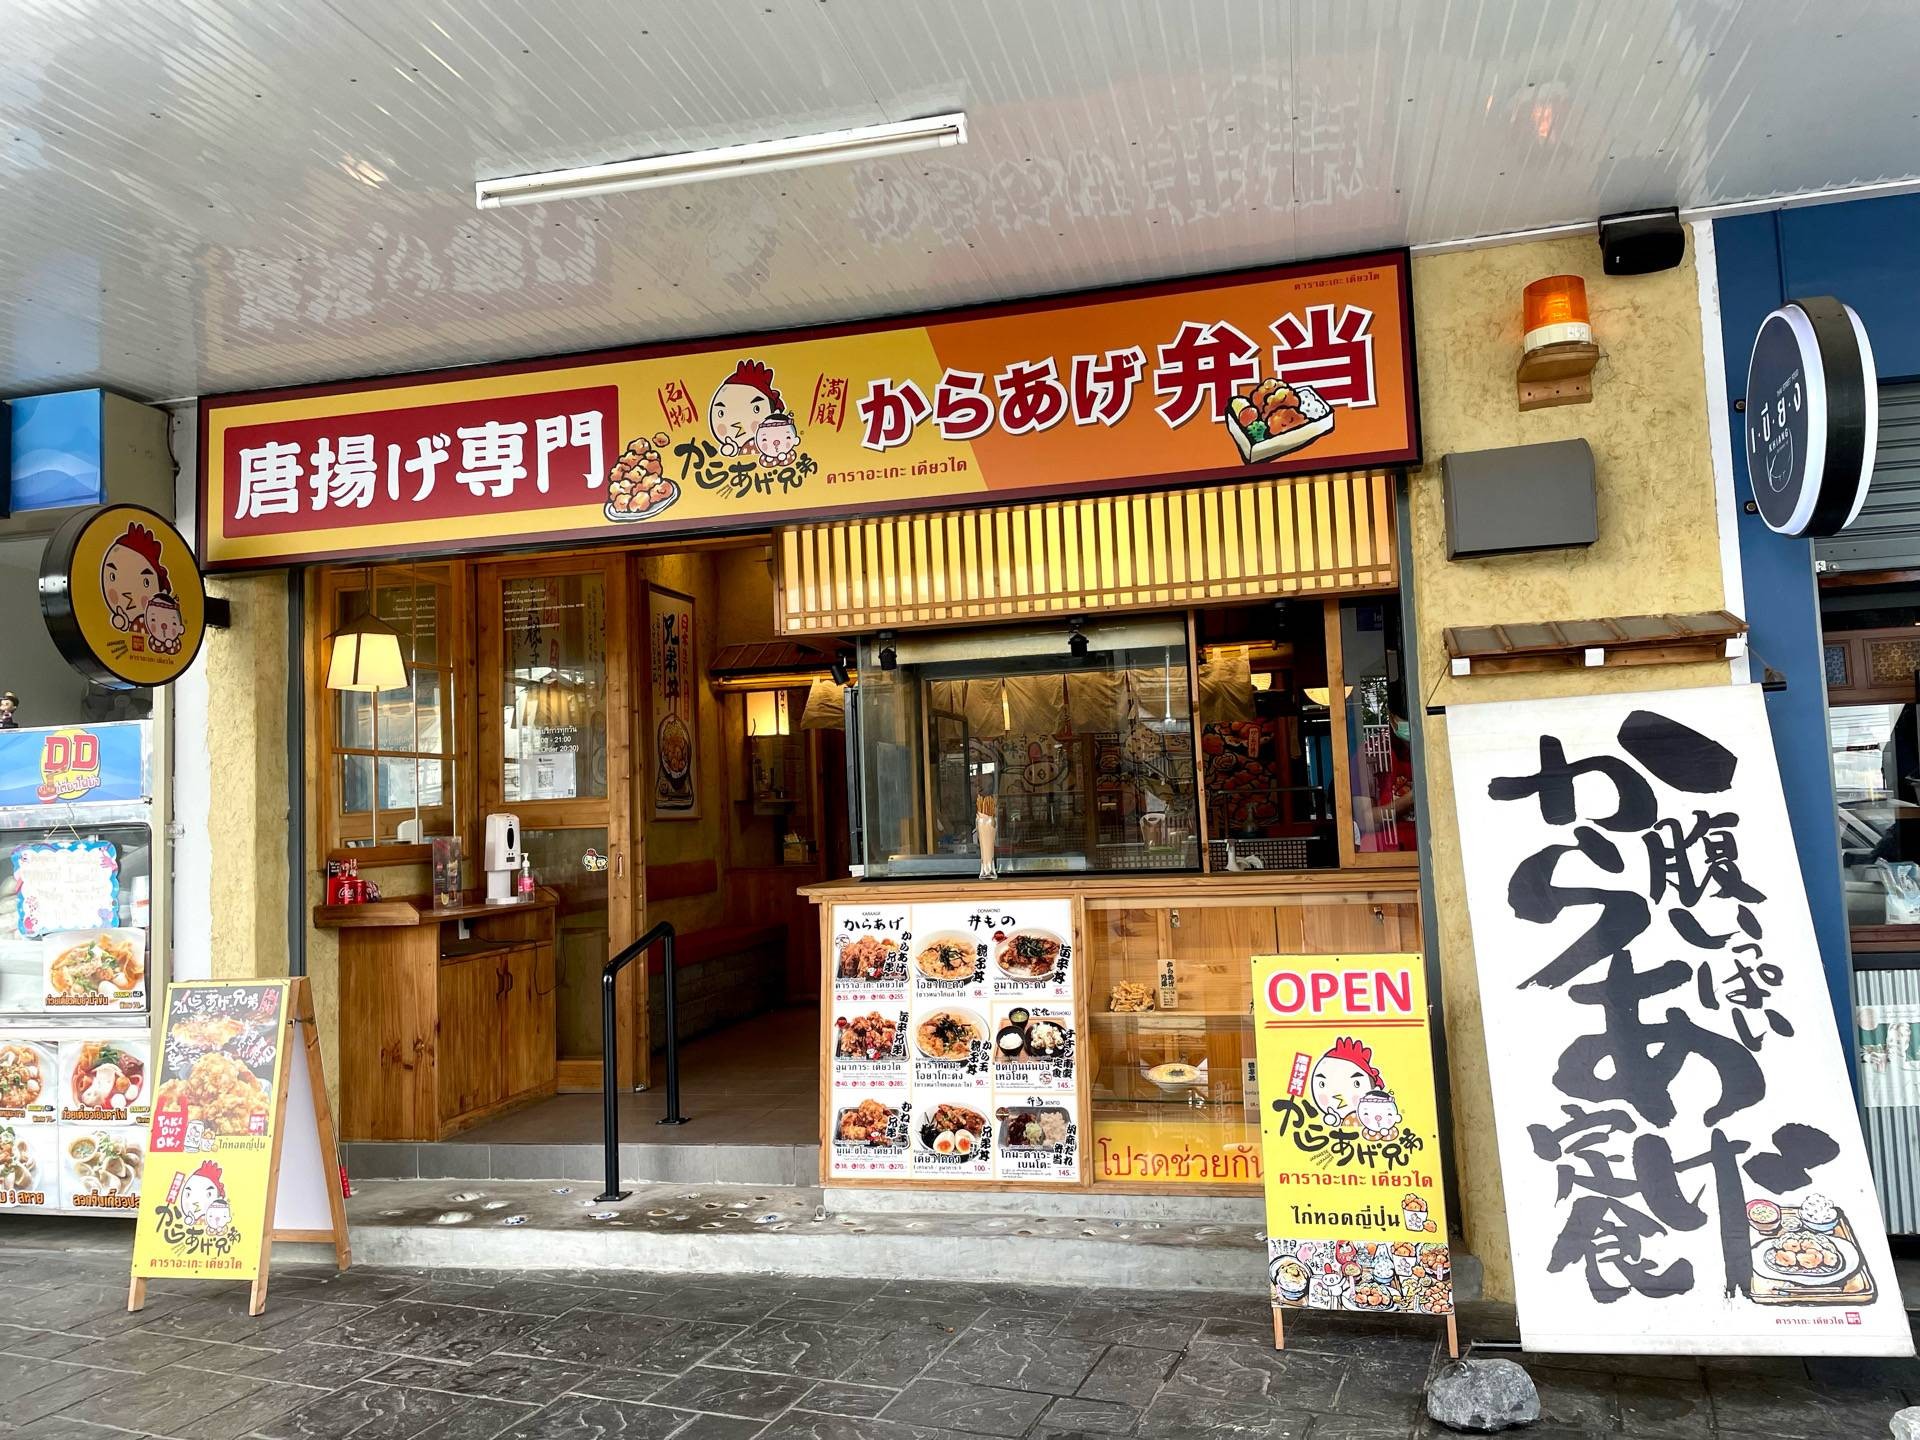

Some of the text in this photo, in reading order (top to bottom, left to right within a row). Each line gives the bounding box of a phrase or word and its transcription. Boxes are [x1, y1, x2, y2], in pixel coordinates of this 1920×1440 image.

[665, 382, 693, 428] 名物
[815, 378, 845, 426] 満腹
[233, 410, 605, 520] 唐揚げ専門
[826, 457, 968, 485] คาราอะเกะ เคียวได
[44, 733, 99, 771] DD
[844, 917, 904, 931] からあげ
[968, 915, 1016, 931] 丼もの
[1642, 809, 1795, 1053] 腹いっぱい
[1268, 971, 1412, 1014] OPEN
[1280, 1170, 1434, 1188] คาราอะเกะ เคียวได
[1291, 1204, 1400, 1232] ไก่ทอดญี่ปุ่น
[1527, 1103, 1694, 1304] 定食
